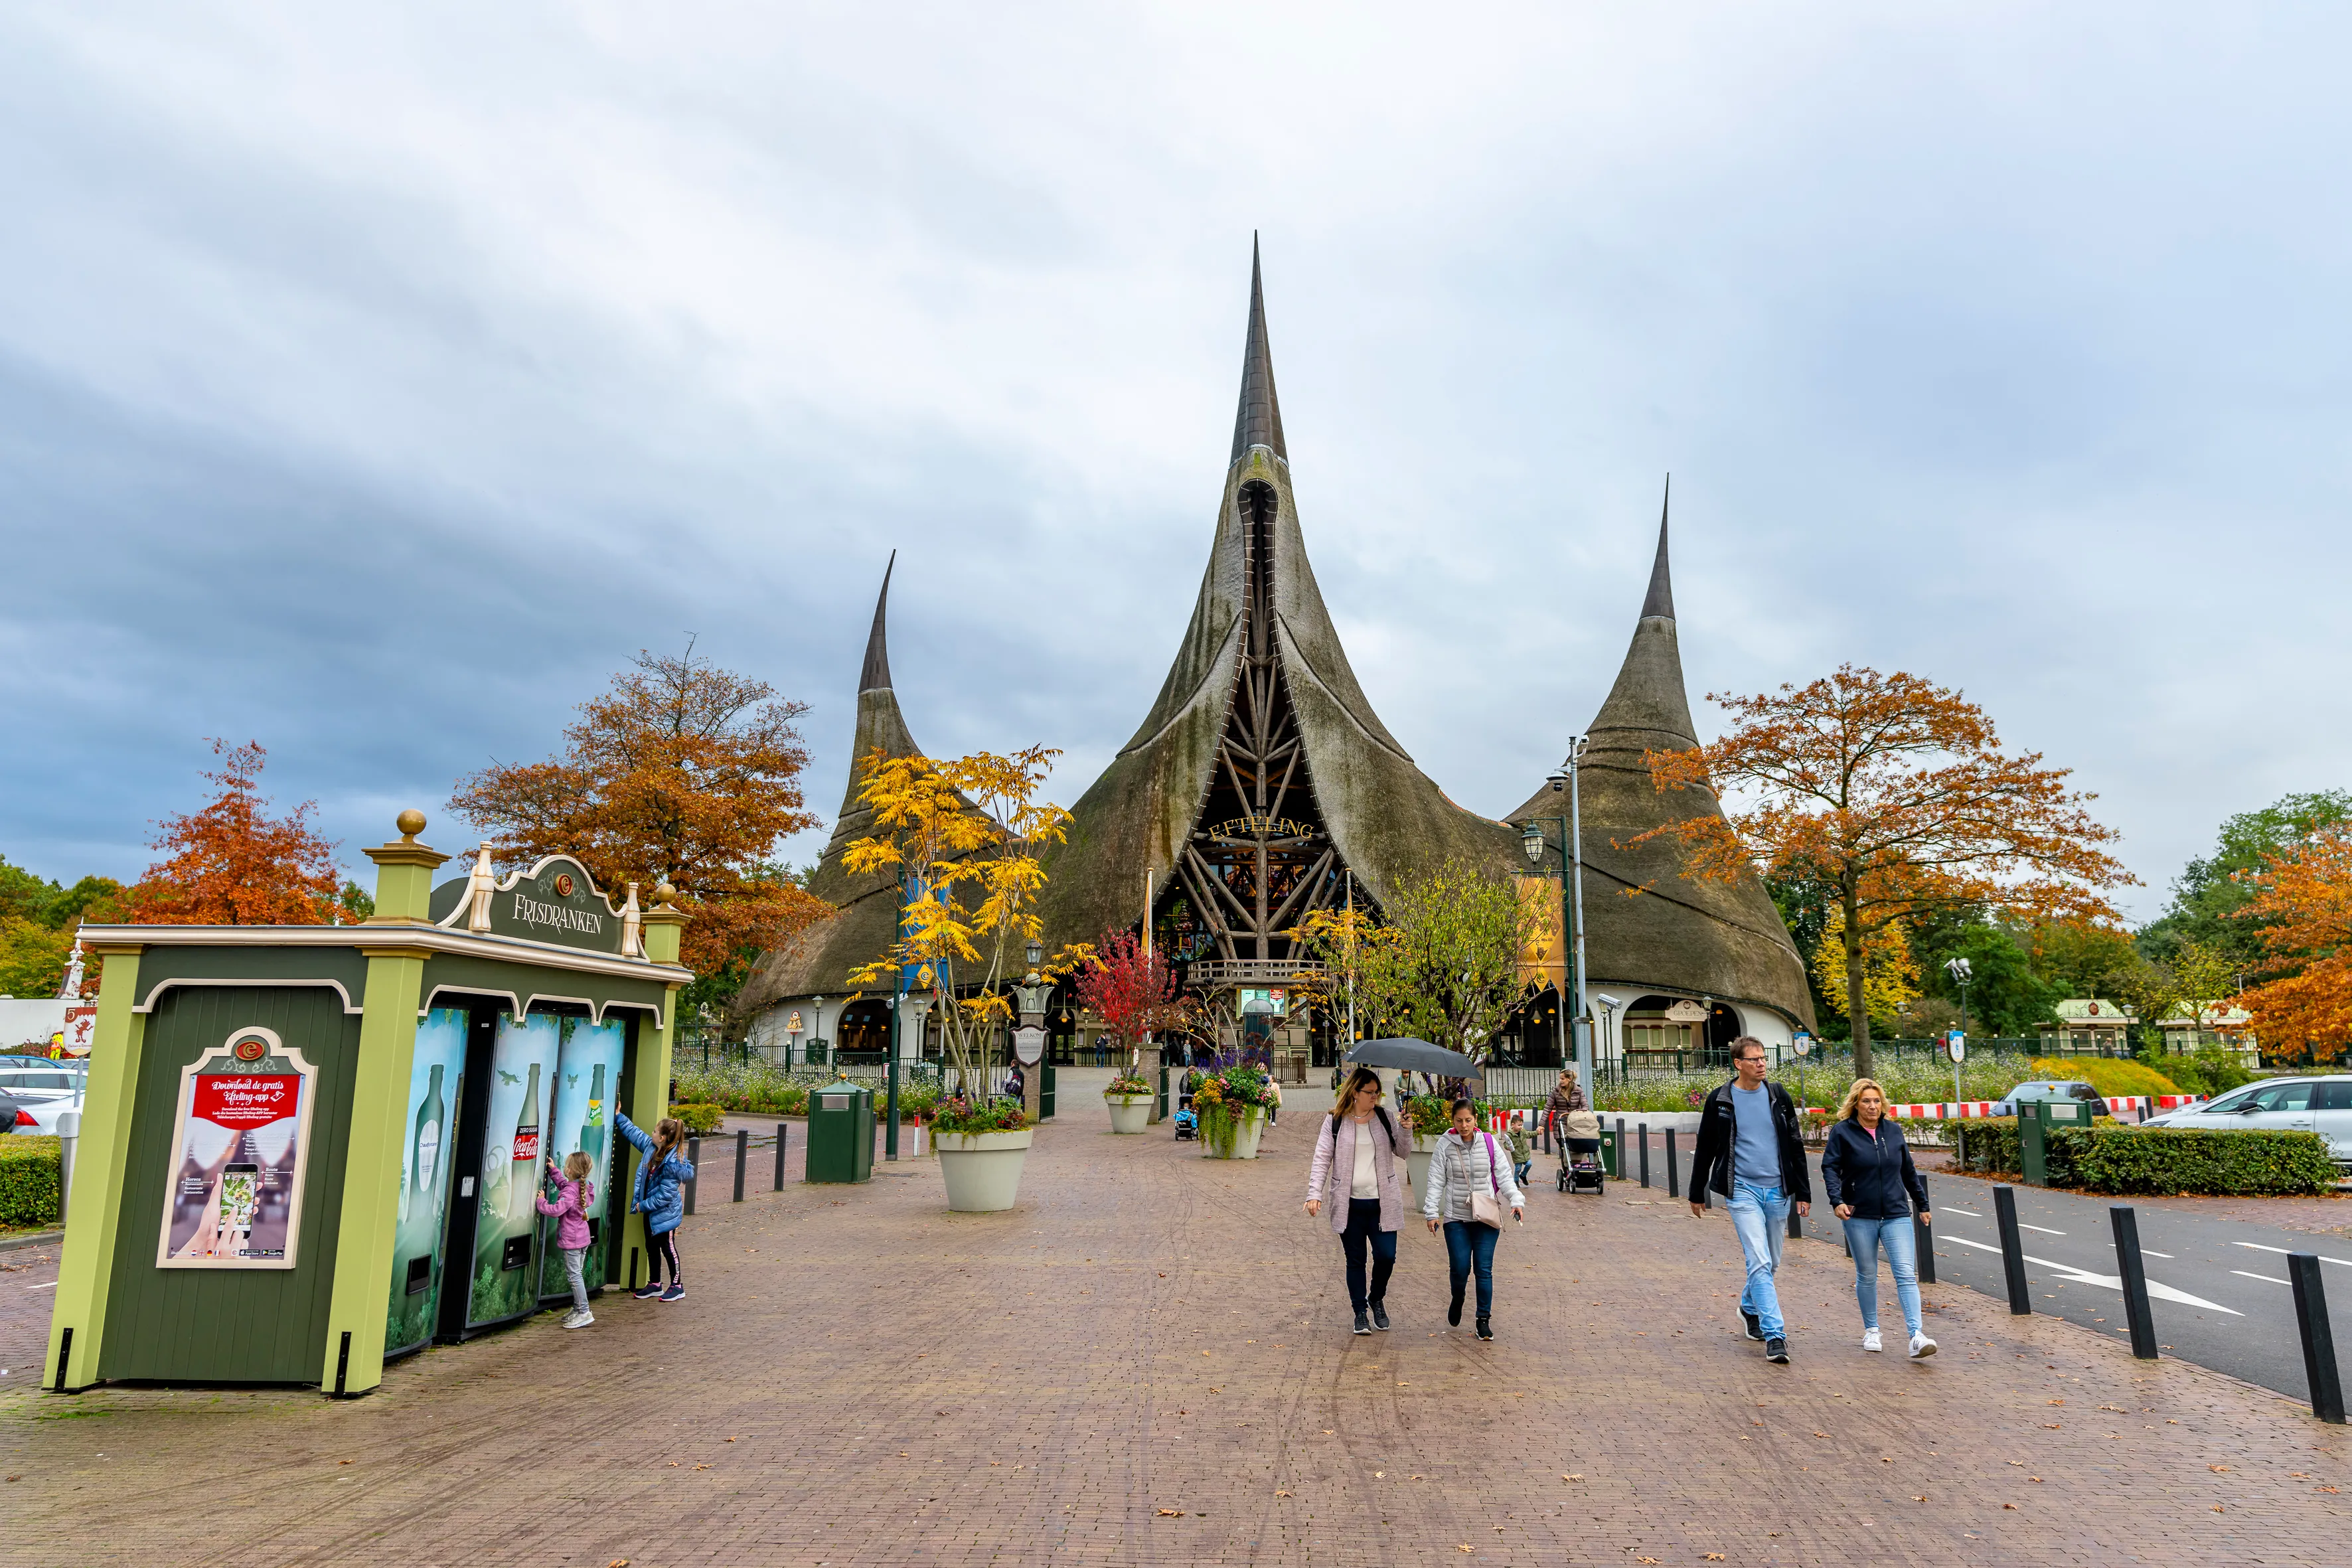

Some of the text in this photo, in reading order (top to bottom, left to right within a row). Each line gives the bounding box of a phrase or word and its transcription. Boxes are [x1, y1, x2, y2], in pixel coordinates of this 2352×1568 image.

[1208, 816, 1315, 842] EFTELING
[512, 893, 603, 935] FRISDRANKEN
[68, 1008, 76, 1020] 5
[211, 1078, 284, 1092] Download de gratis
[223, 1090, 269, 1106] Efteling-app
